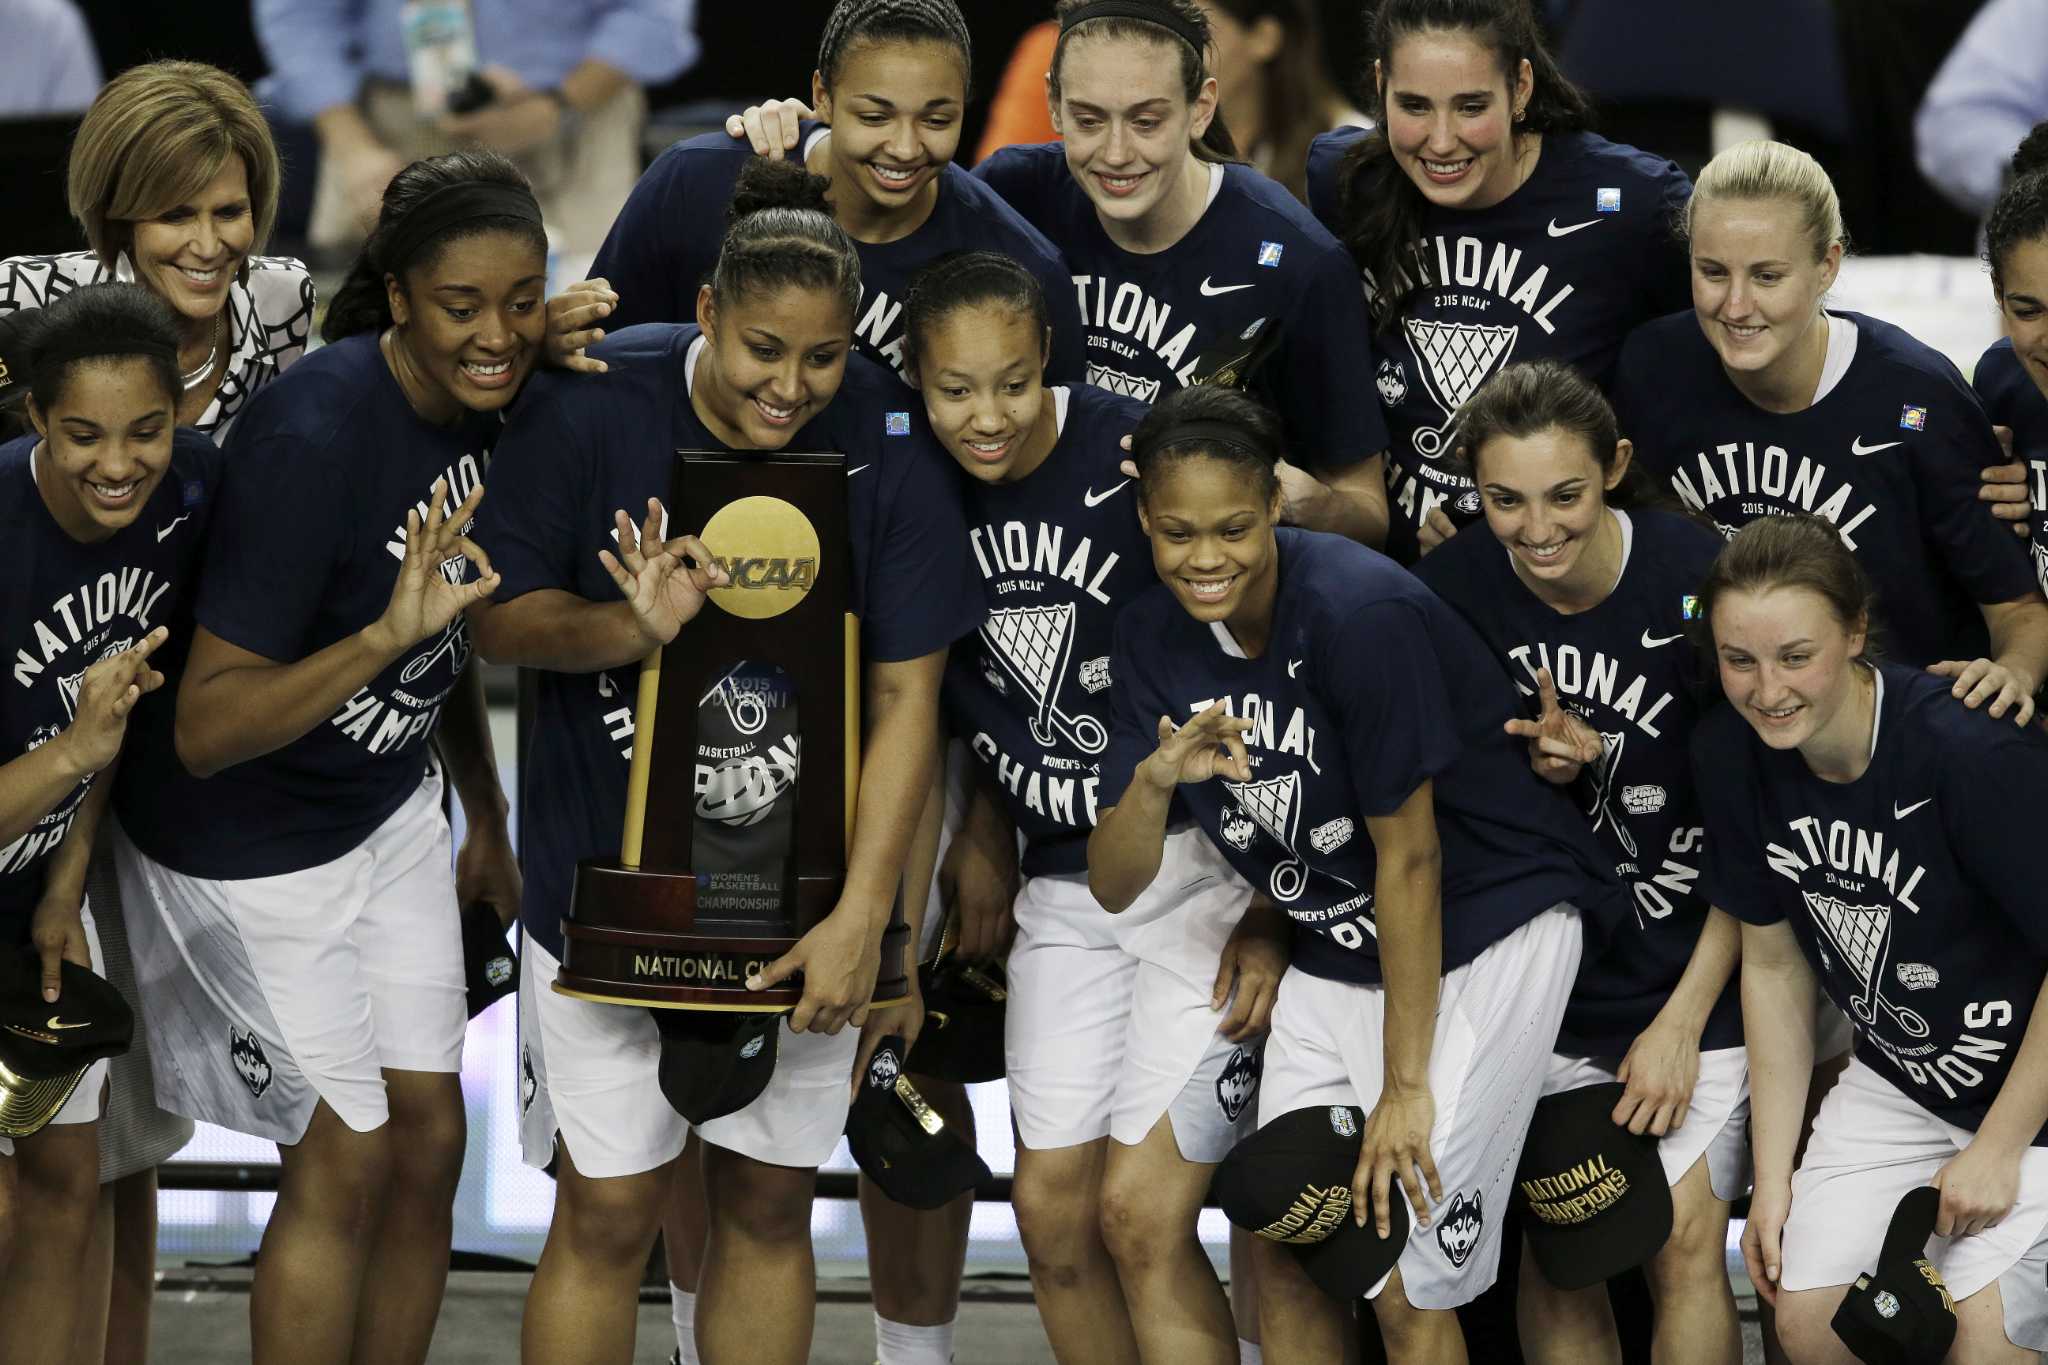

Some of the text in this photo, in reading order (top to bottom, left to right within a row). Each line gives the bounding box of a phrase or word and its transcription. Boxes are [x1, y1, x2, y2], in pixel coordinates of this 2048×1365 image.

[1071, 275, 1200, 389] TIONAL
[1087, 335, 1109, 348] 2015
[1671, 441, 1877, 551] NATIONAL
[1741, 502, 1764, 514] 2015
[969, 521, 1120, 605] TIONAL
[996, 580, 1017, 595] 2015
[732, 677, 770, 691] 2015
[1508, 642, 1674, 738] TIONAL
[698, 742, 757, 760] BASKETBALL
[1042, 754, 1081, 770] WOMEN'S
[711, 873, 761, 882] WOMEN'S
[711, 881, 780, 891] BASKETBALL
[697, 896, 780, 910] CHAMPIONSHIP
[634, 955, 739, 980] NATIONAL
